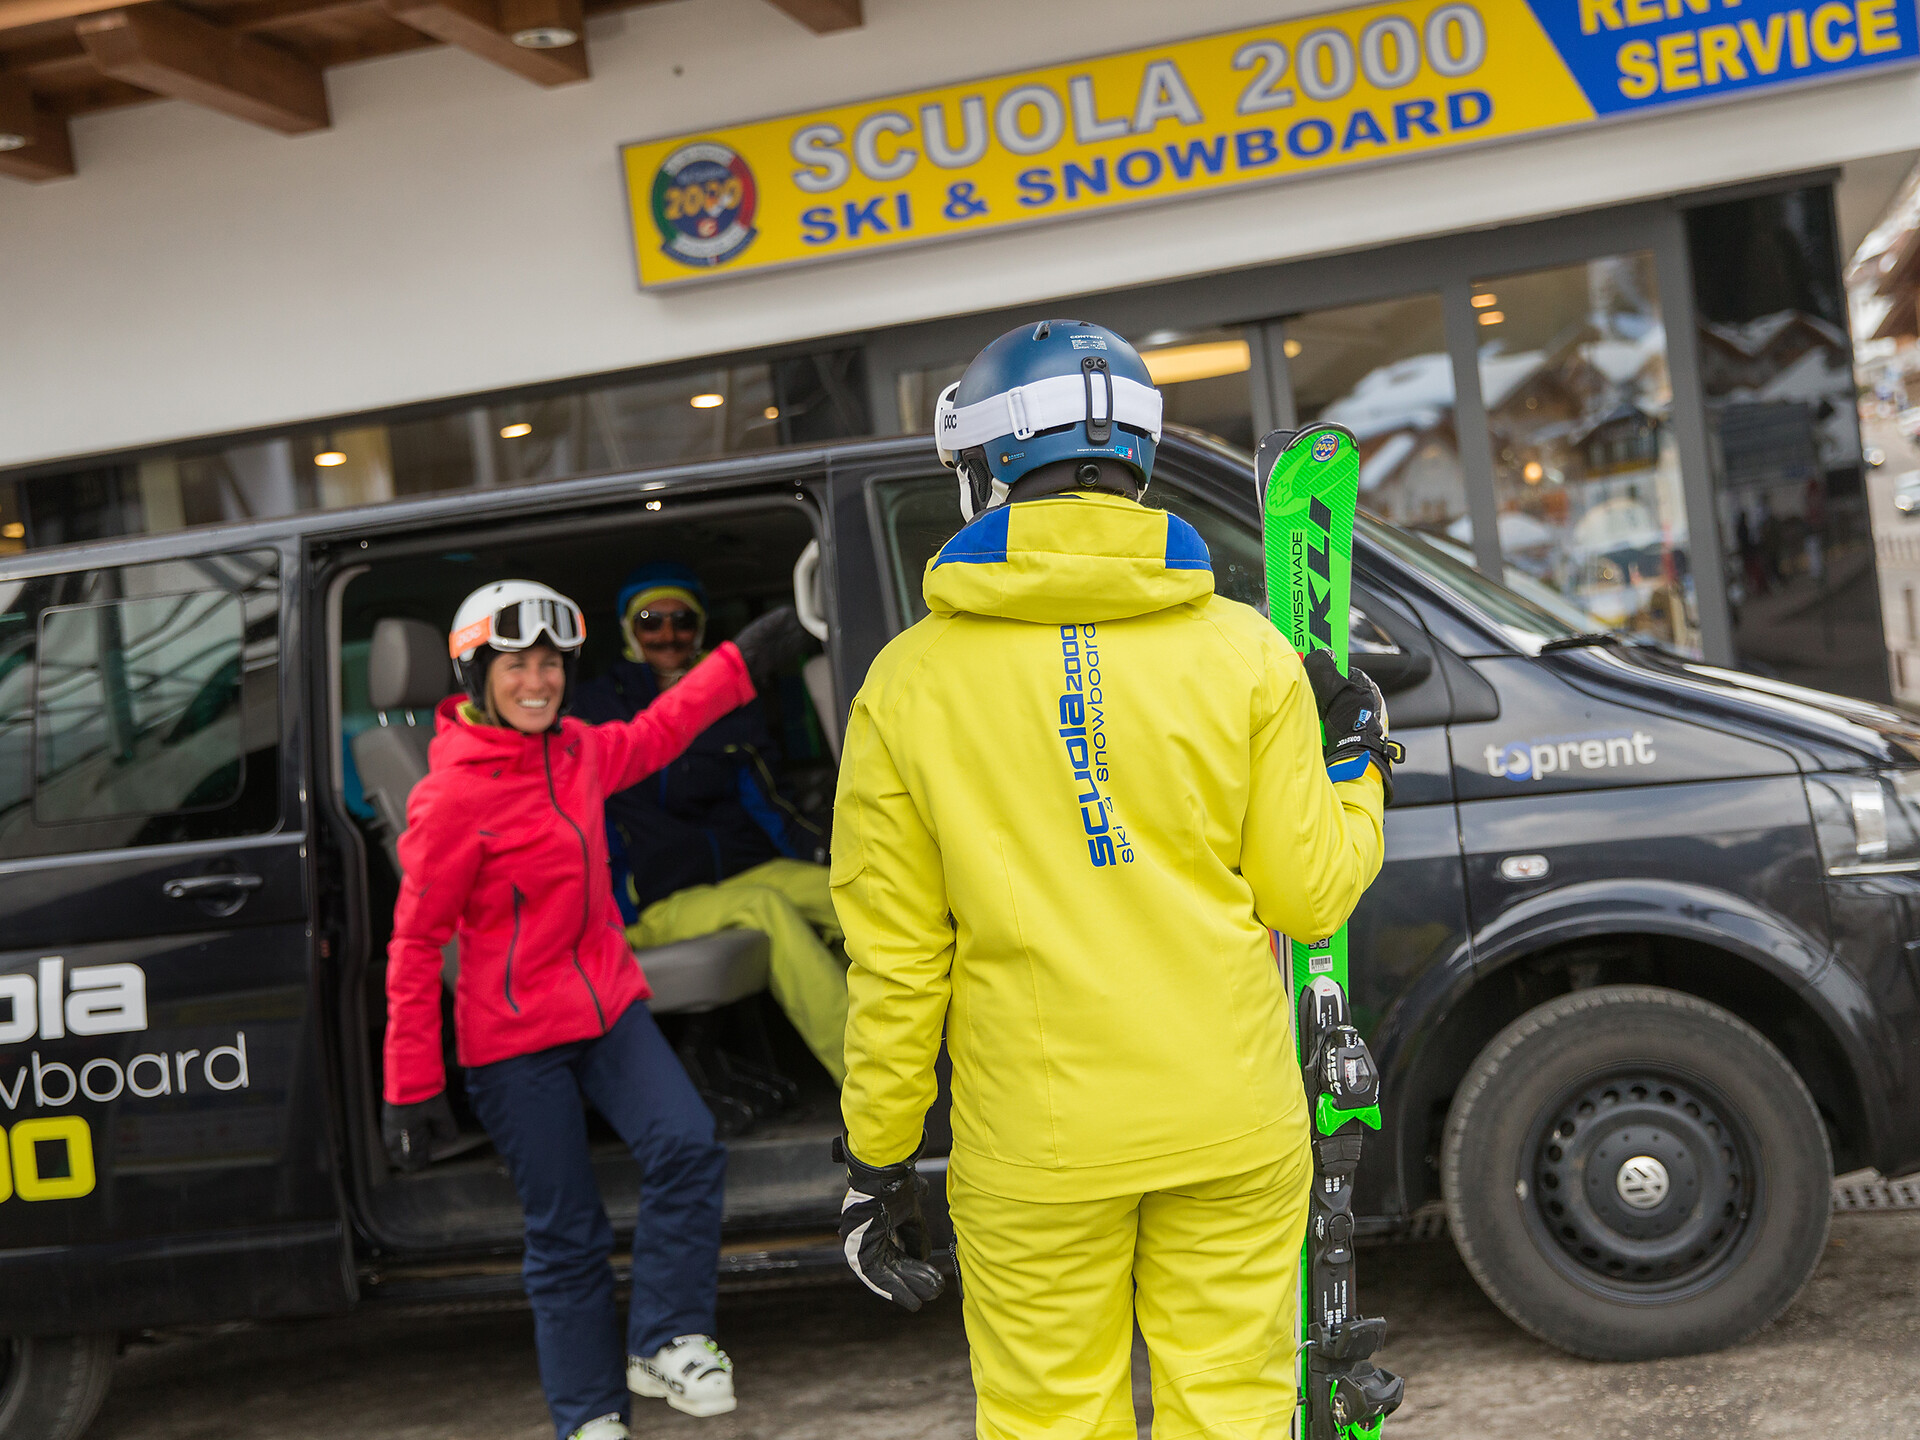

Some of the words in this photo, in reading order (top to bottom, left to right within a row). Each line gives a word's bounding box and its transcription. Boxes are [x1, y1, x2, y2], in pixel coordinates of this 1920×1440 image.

[1578, 0, 1742, 35] RE
[1616, 0, 1902, 99] SERVICE
[789, 58, 1203, 193] SCUOLA
[1231, 3, 1487, 116] 2000
[800, 191, 914, 248] SKI
[942, 180, 990, 221] &
[1016, 89, 1493, 208] SNOWBOARD
[1292, 532, 1303, 589] MADE
[1307, 495, 1332, 650] KLI
[1293, 590, 1304, 647] SWISS
[1079, 623, 1109, 782] snowboard
[1483, 731, 1656, 781] toprent
[1112, 826, 1134, 864] ski
[0, 1115, 96, 1202] 0
